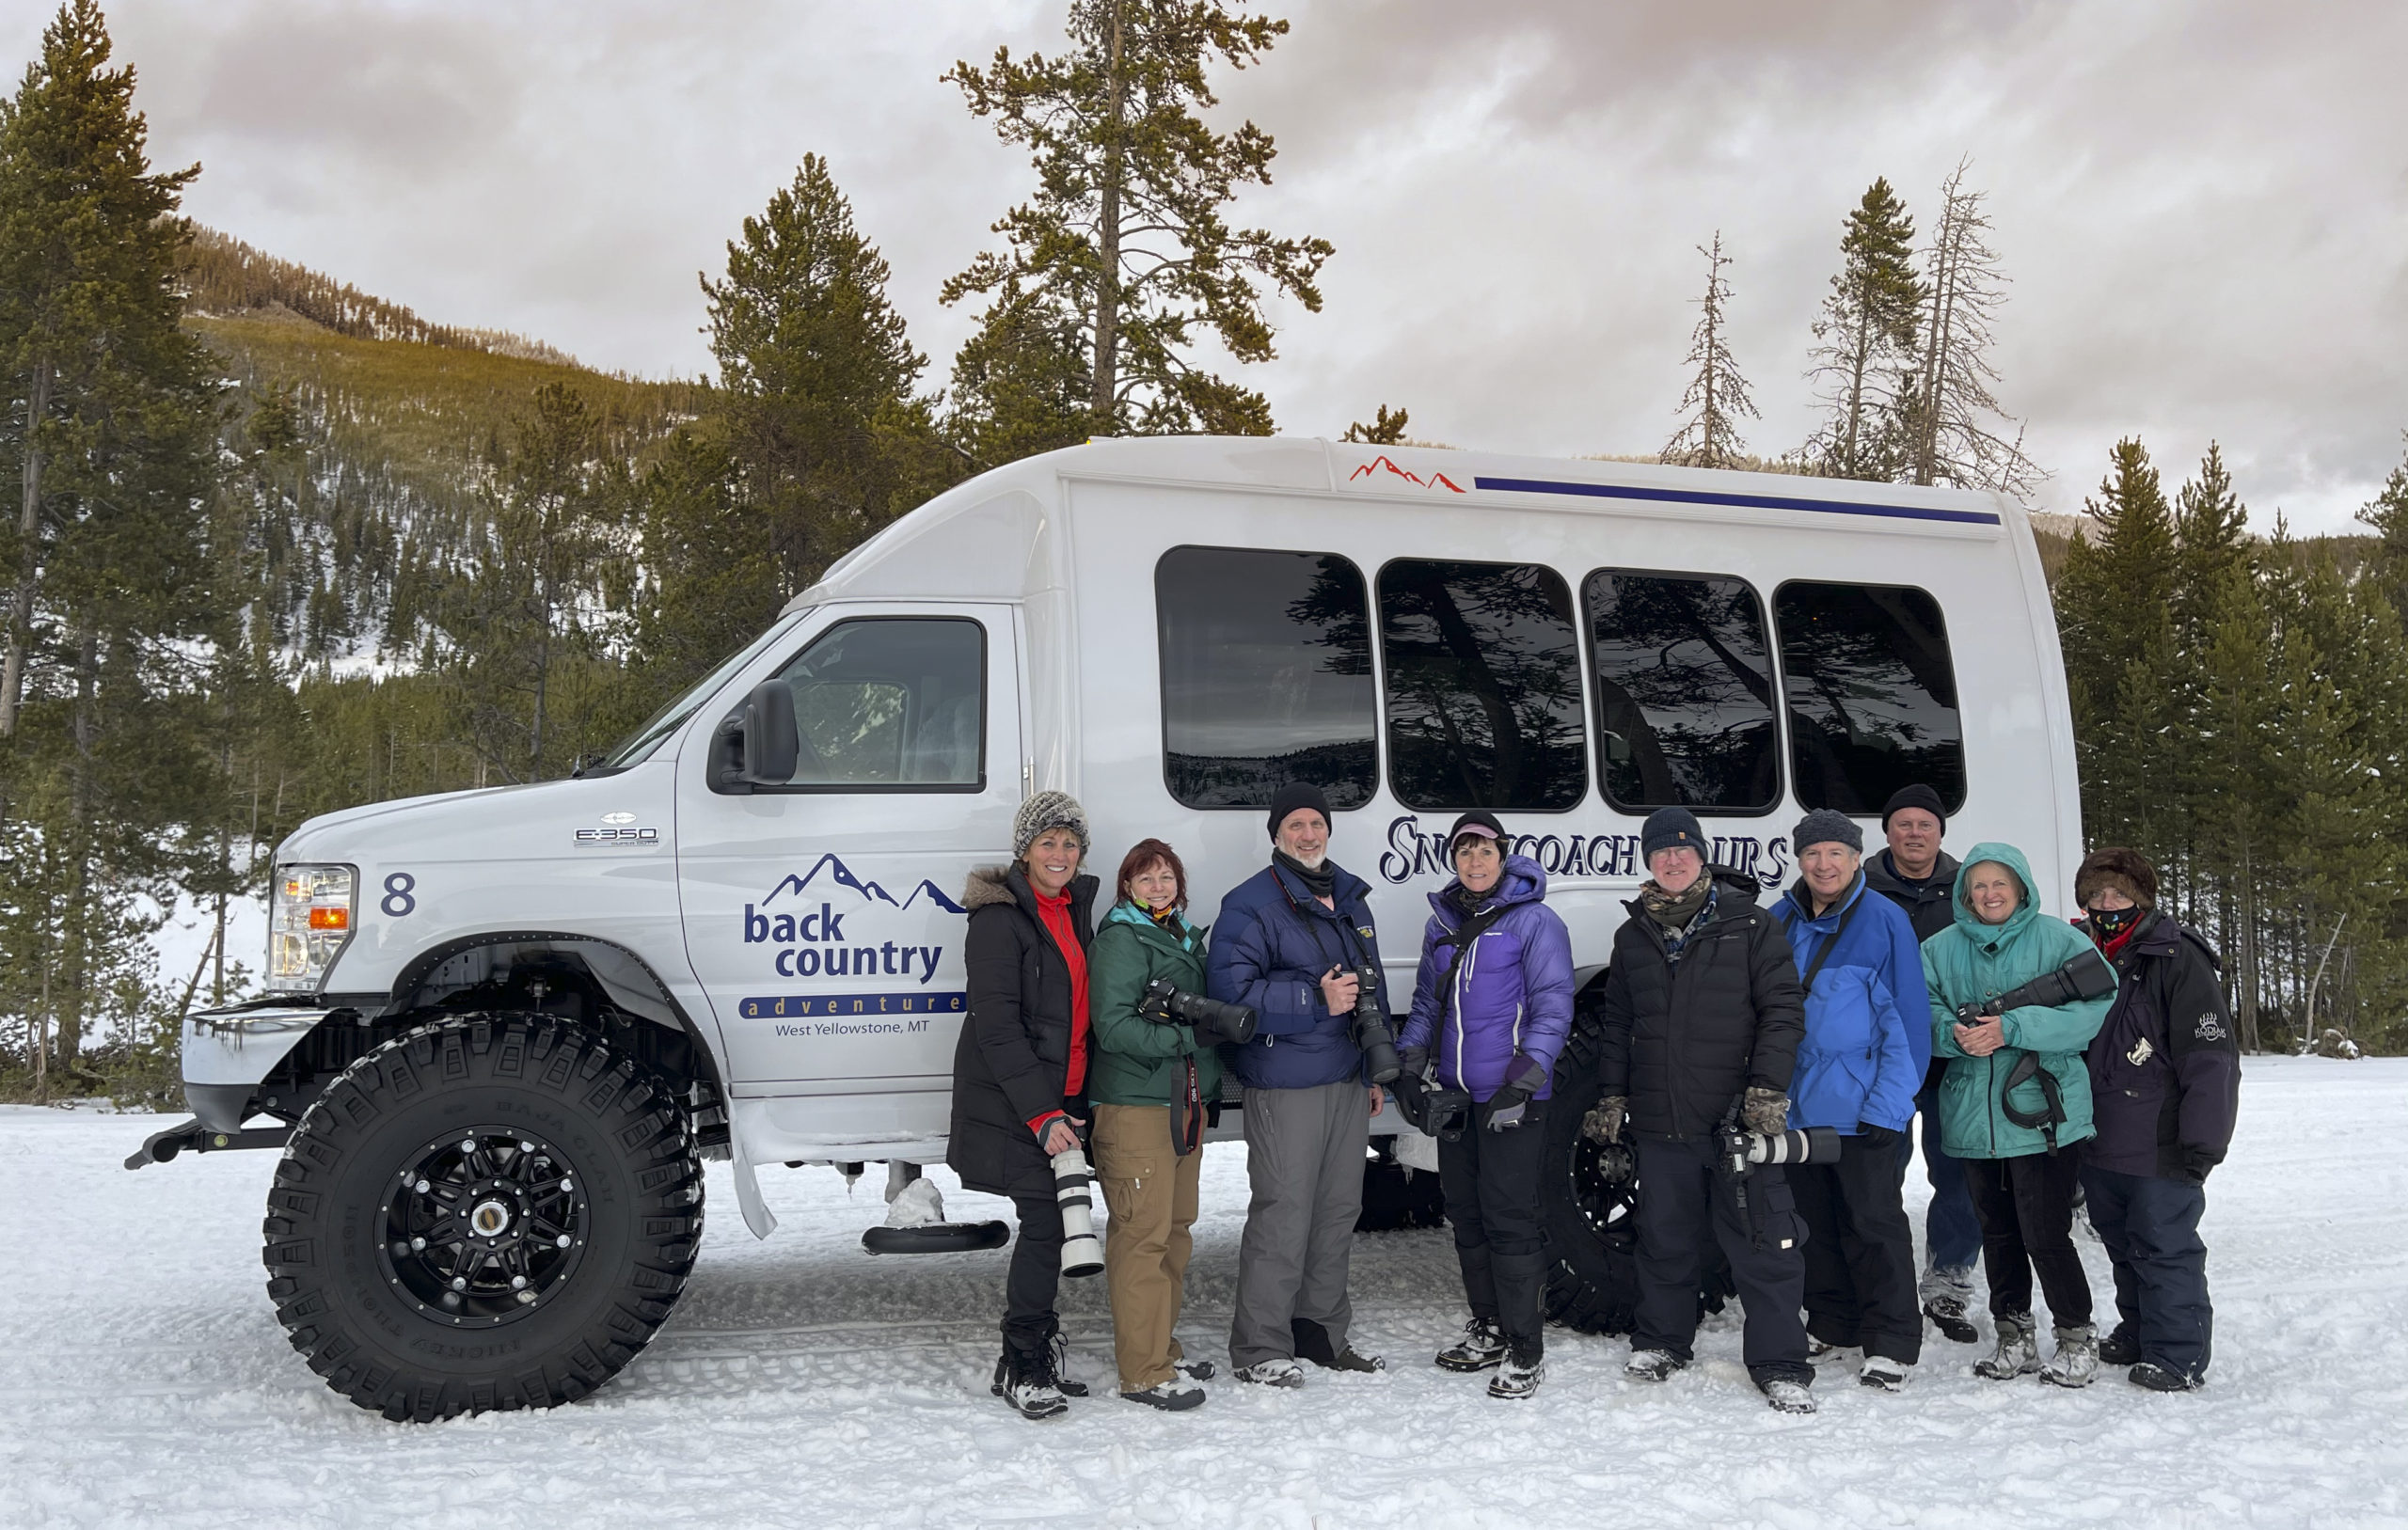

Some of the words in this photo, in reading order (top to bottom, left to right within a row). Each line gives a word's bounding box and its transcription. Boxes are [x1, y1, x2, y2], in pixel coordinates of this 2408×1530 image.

[576, 828, 657, 841] E-350
[1379, 815, 1642, 884] SNCOACH
[1705, 836, 1789, 890] URS
[381, 872, 416, 917] 8
[744, 903, 845, 943] back
[774, 940, 943, 986] country
[747, 994, 960, 1017] adventure
[776, 1024, 811, 1036] West
[815, 1021, 904, 1035] Yellowstone,
[908, 1020, 930, 1033] MT
[2194, 1025, 2226, 1039] KODIAK
